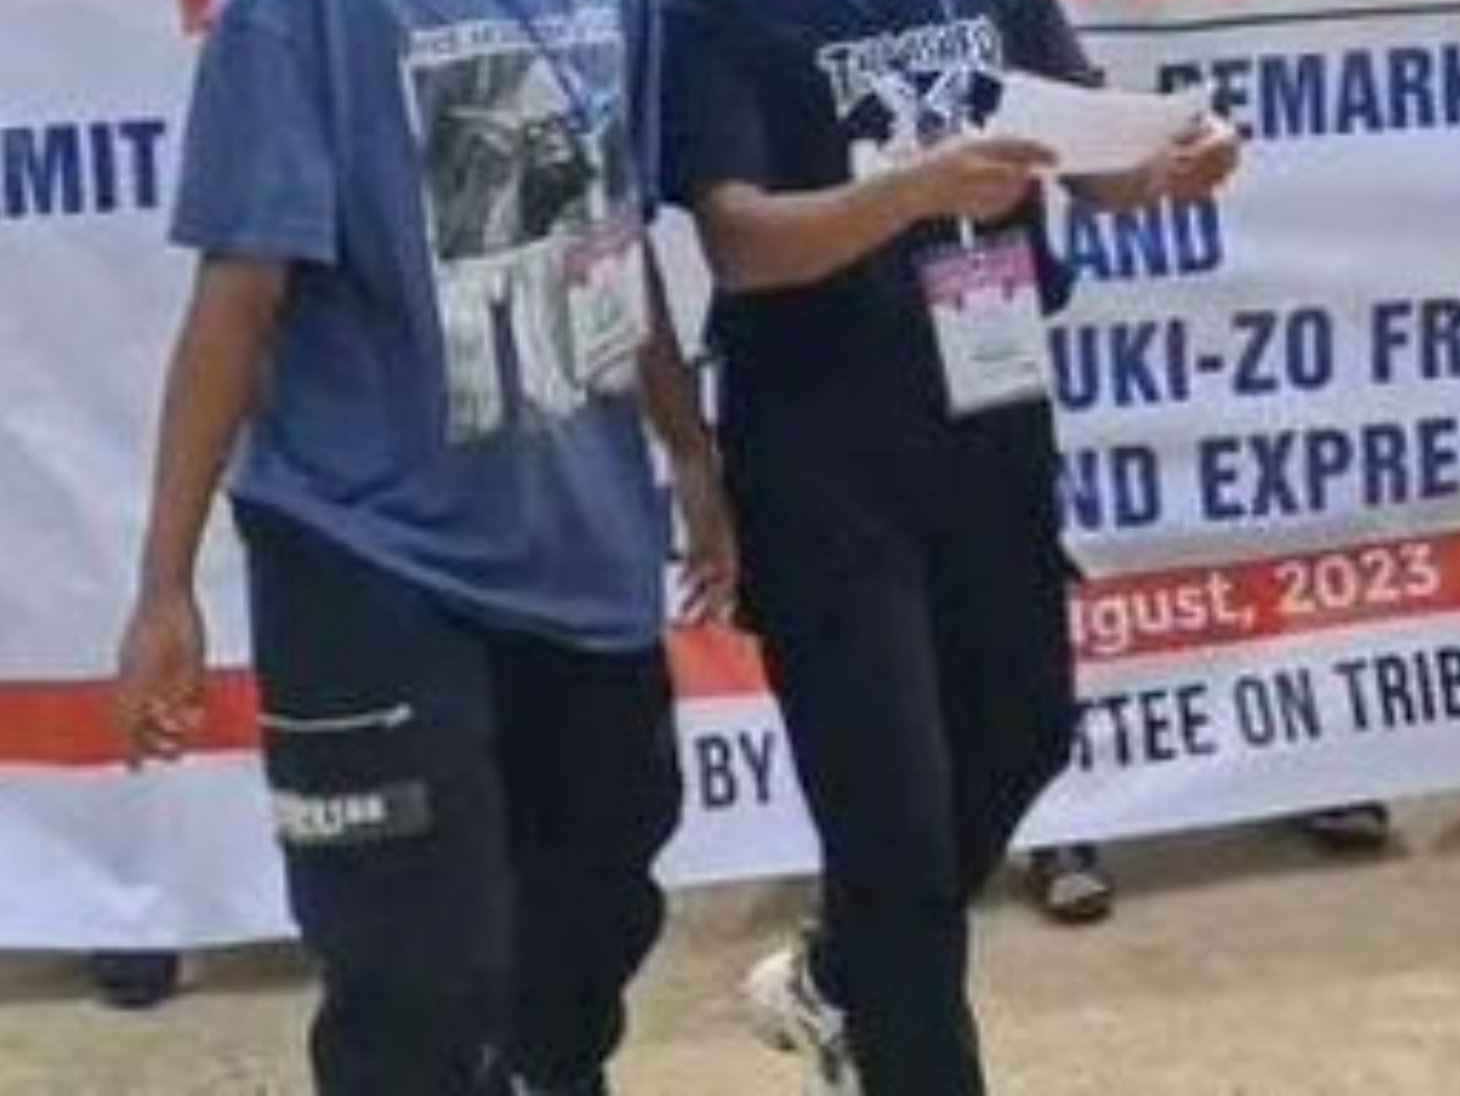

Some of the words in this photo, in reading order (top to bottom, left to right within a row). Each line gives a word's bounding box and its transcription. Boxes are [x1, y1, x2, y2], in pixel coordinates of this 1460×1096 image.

[1276, 541, 1442, 617] 2023
[1233, 670, 1323, 747] ON
[694, 730, 775, 811] BY
